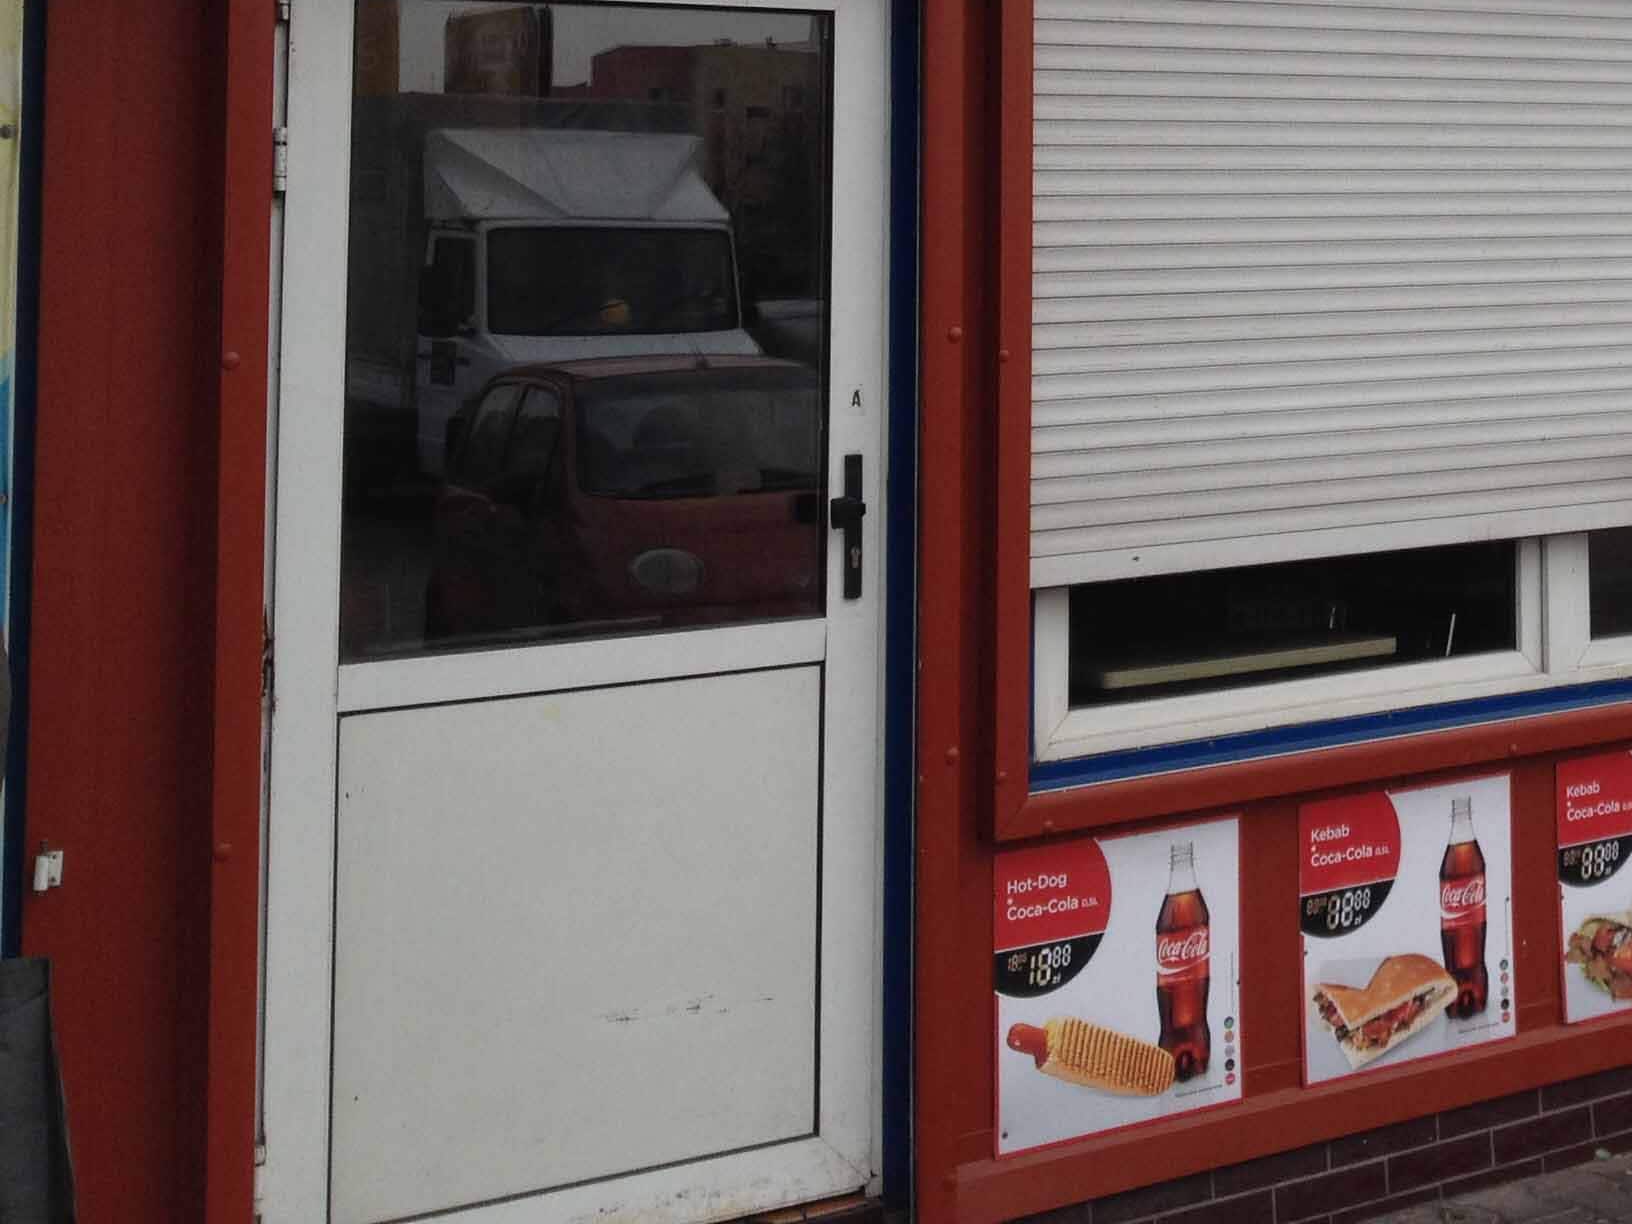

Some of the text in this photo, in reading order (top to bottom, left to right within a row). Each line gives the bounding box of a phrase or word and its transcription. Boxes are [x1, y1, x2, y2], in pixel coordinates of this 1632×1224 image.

[1566, 780, 1600, 799] Kebab
[1567, 800, 1620, 822] Coca-Cola
[1311, 824, 1350, 843] Kebab
[1311, 844, 1373, 867] Coca-Cola
[1007, 873, 1068, 895] Hot-Dog
[1007, 896, 1079, 921] Coca-Cola
